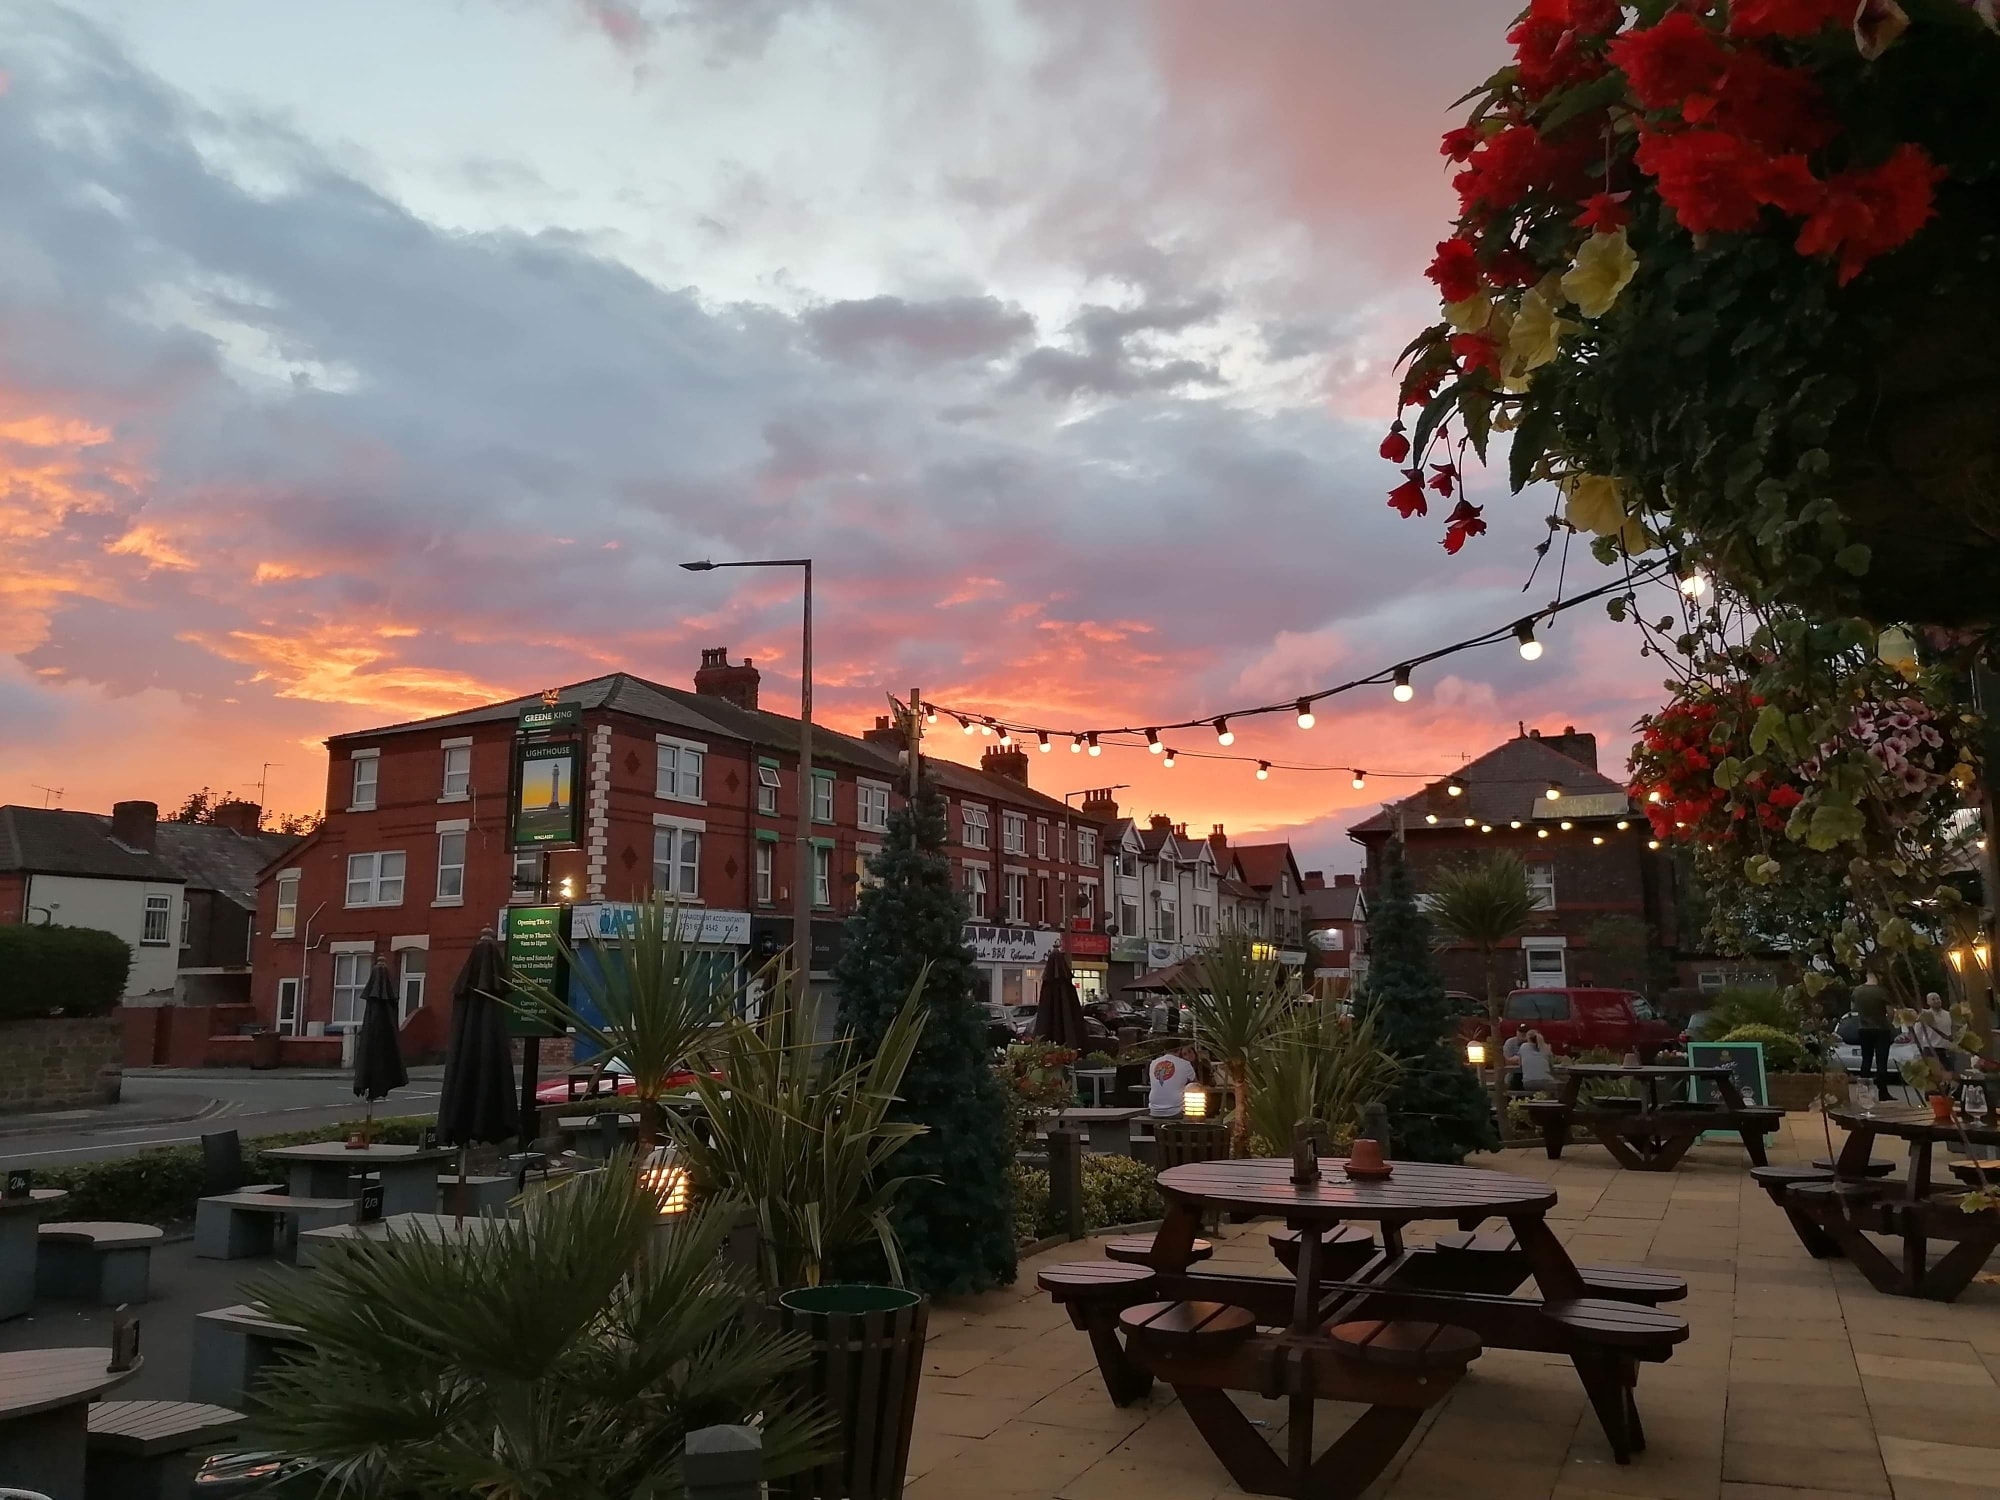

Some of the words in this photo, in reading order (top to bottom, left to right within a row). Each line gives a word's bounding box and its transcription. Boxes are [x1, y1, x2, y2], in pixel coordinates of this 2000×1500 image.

[525, 713, 552, 722] GREENE
[553, 711, 572, 719] KING
[526, 746, 570, 757] LIGHTHOUSE
[713, 915, 745, 923] ACCOUNTANTS
[705, 923, 719, 931] 4542
[965, 927, 1036, 946] AMARA
